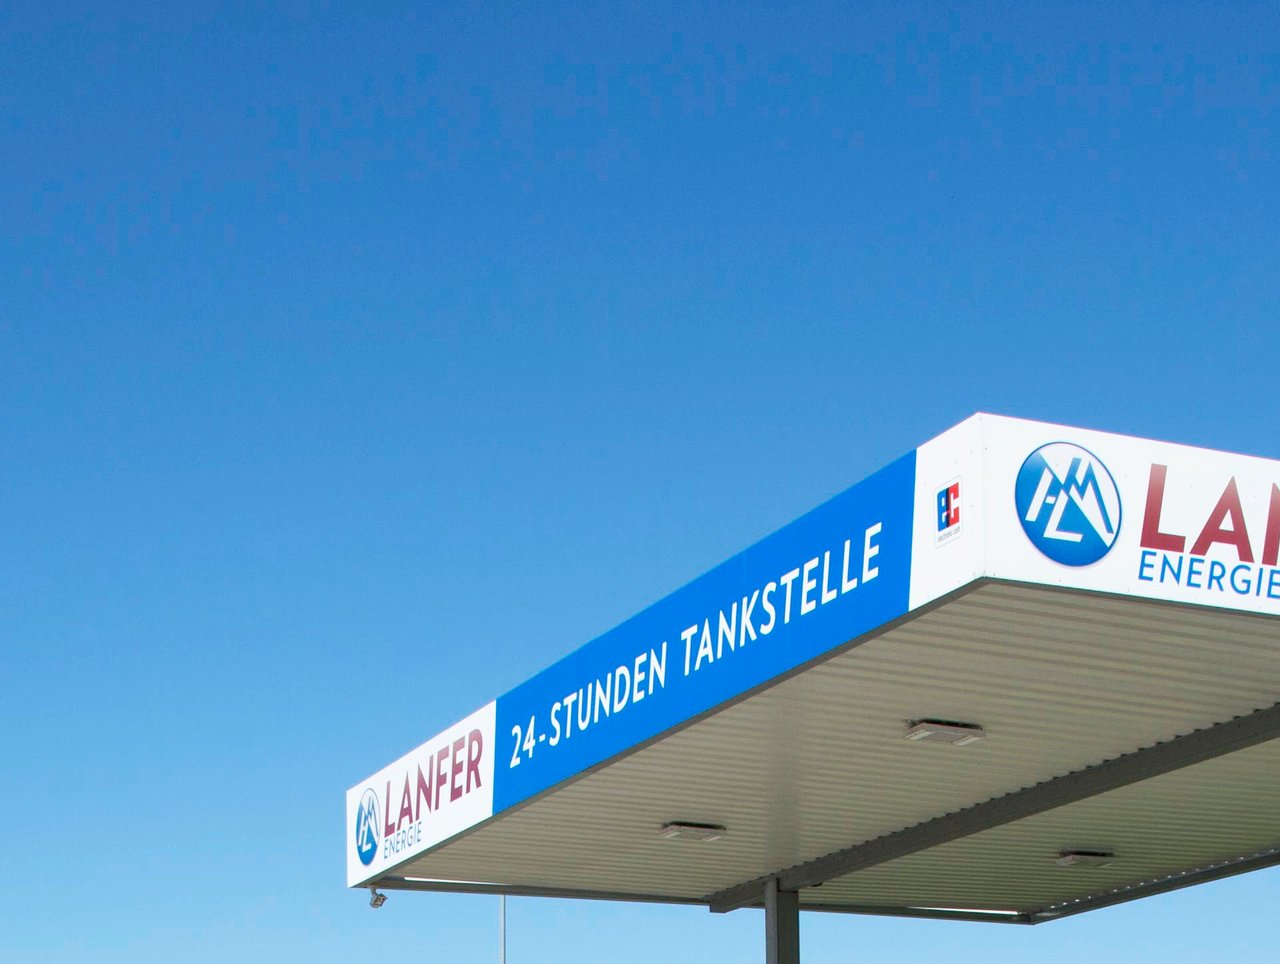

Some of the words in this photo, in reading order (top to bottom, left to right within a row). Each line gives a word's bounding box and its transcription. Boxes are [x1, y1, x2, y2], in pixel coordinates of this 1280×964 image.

[508, 641, 669, 769] 24-STUNDEN
[680, 521, 883, 677] TANKSTELLE
[384, 728, 484, 838] LANFER
[383, 820, 422, 860] ENERGIE
